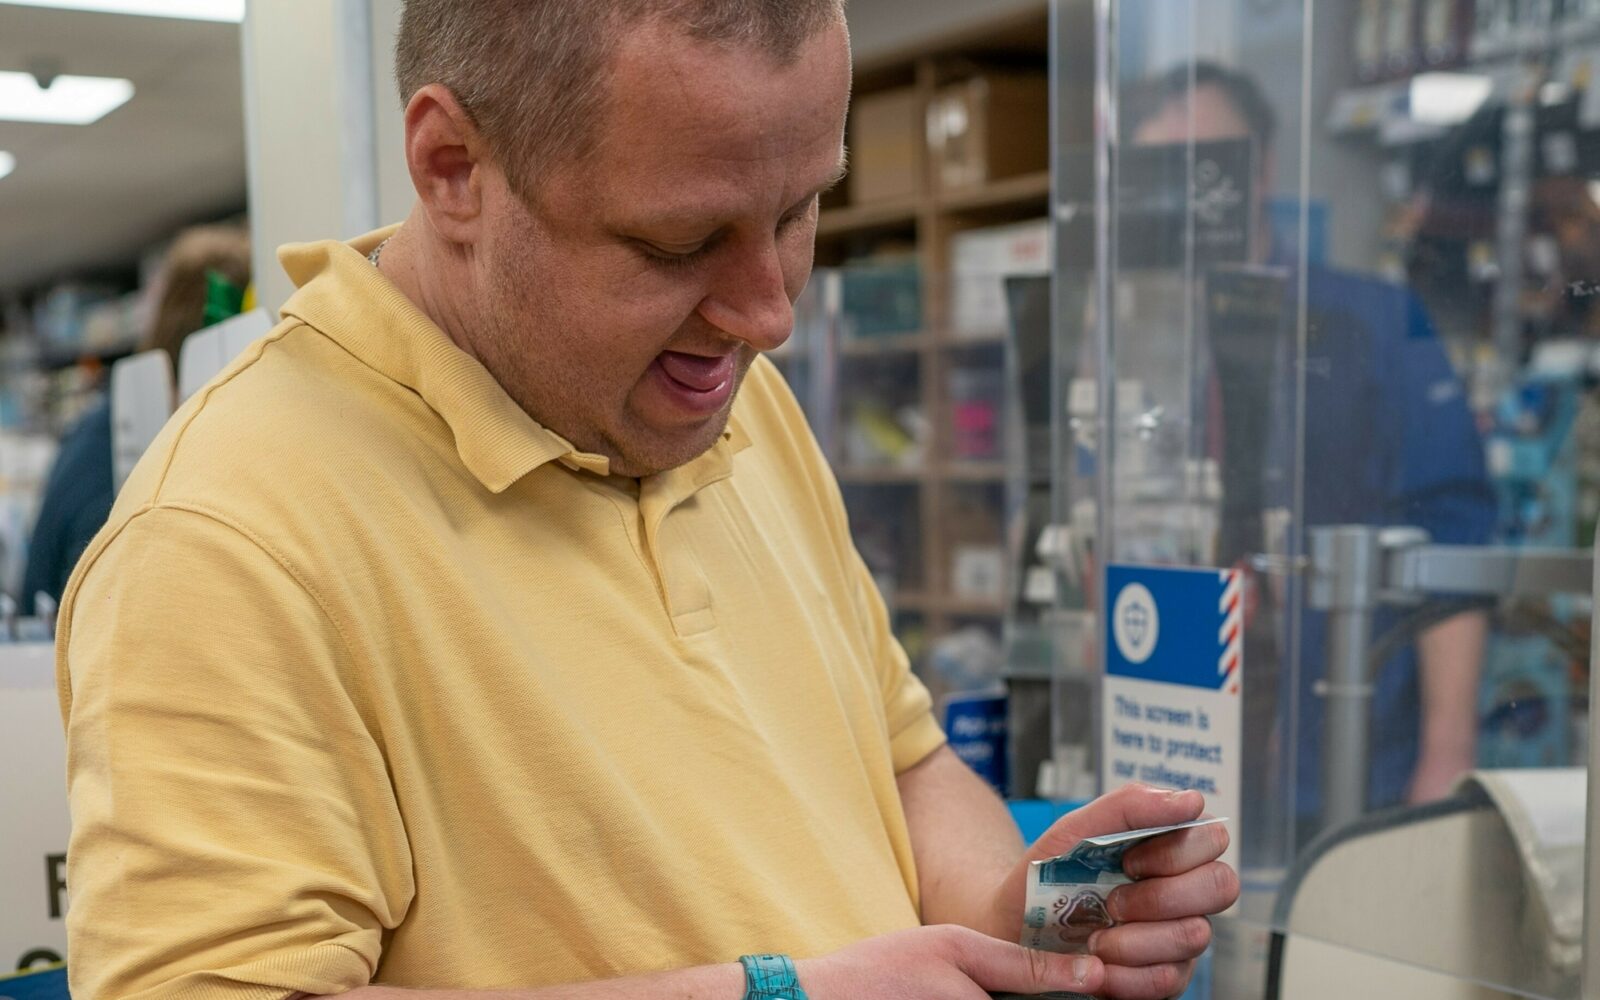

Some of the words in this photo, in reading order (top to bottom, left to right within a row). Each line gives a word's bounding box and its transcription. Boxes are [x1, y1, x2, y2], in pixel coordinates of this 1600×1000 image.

[1114, 695, 1141, 718] This
[1146, 704, 1192, 726] screen
[1197, 706, 1209, 730] is
[1114, 728, 1144, 750] here
[1148, 735, 1162, 754] to
[1167, 739, 1222, 763] protect
[1114, 761, 1135, 778] our
